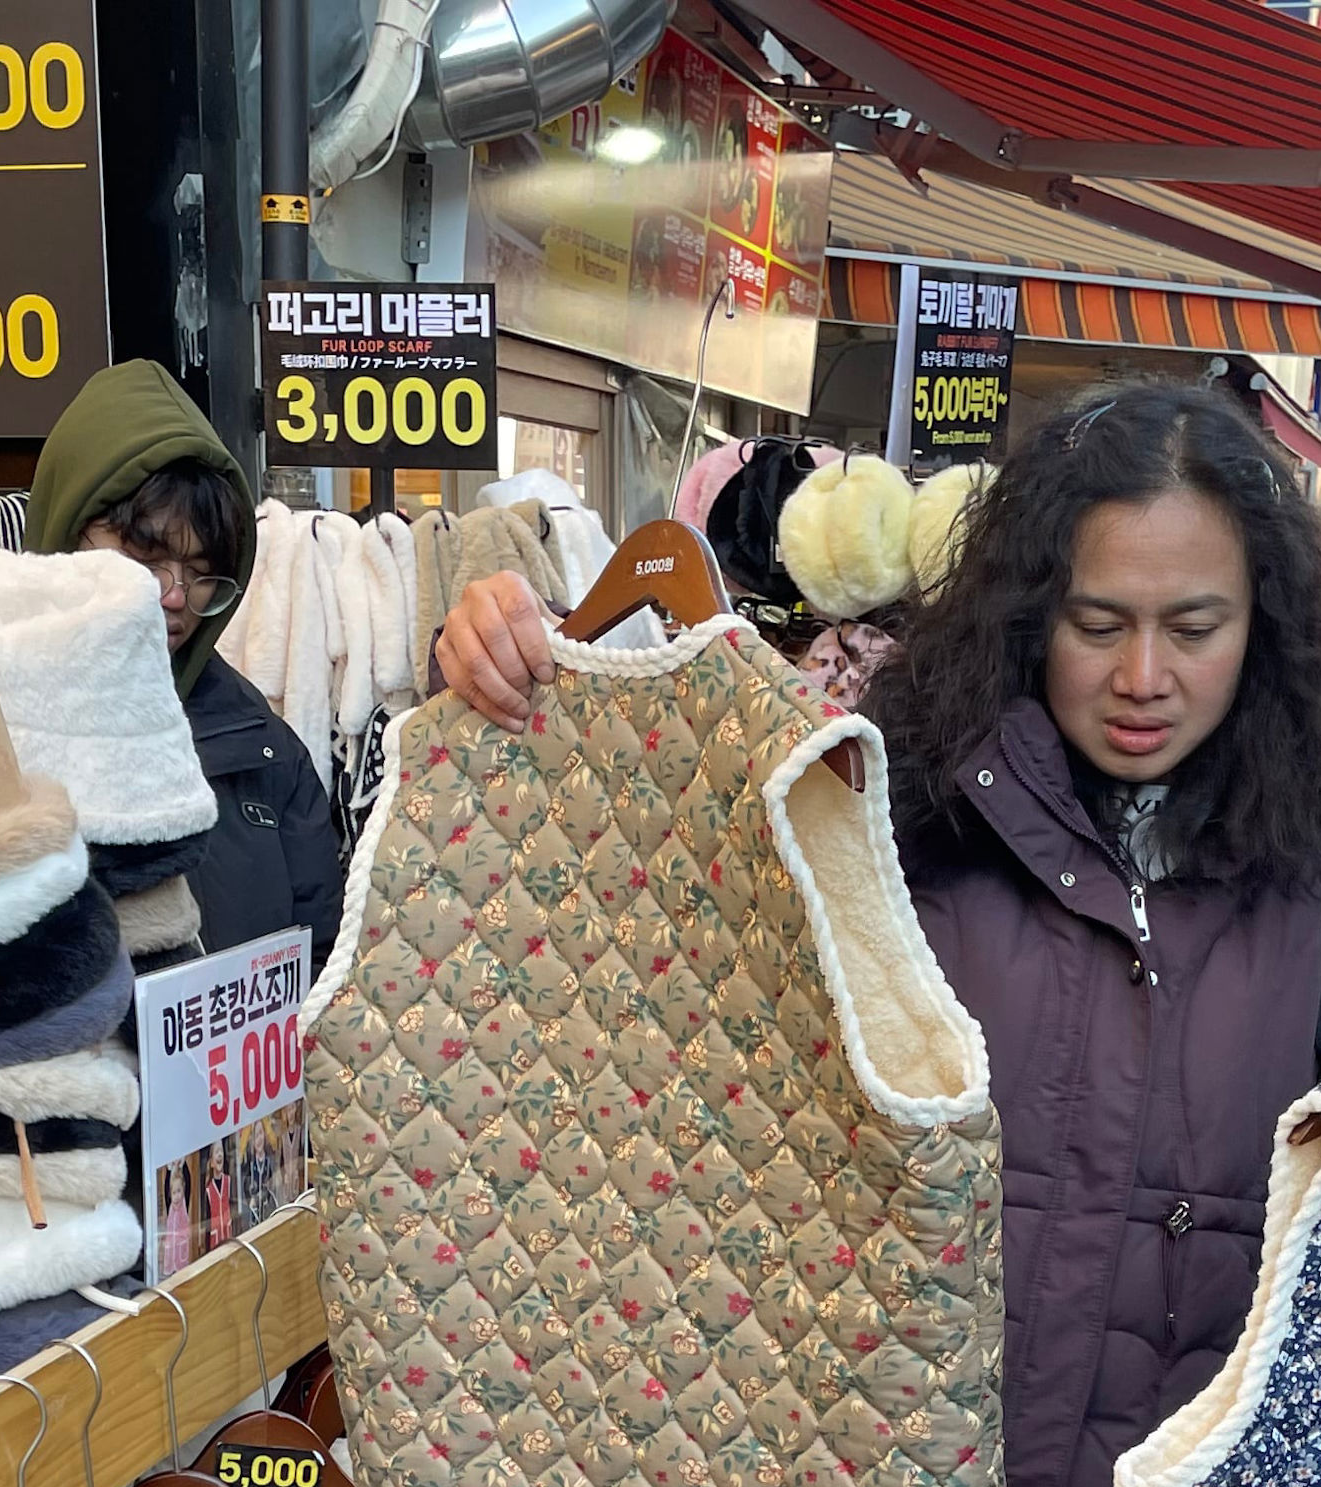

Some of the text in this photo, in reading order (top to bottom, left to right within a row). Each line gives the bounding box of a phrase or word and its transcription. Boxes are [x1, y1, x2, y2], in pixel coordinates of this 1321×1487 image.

[267, 292, 491, 338] 퍼고리 머플러
[918, 280, 1018, 331] 토끼털 귀마개
[321, 339, 433, 353] FUR LOOP SCARF
[276, 375, 487, 446] 3,000
[635, 556, 675, 577] 5,000원
[162, 994, 203, 1057] 아동
[208, 1013, 303, 1127] 5,000
